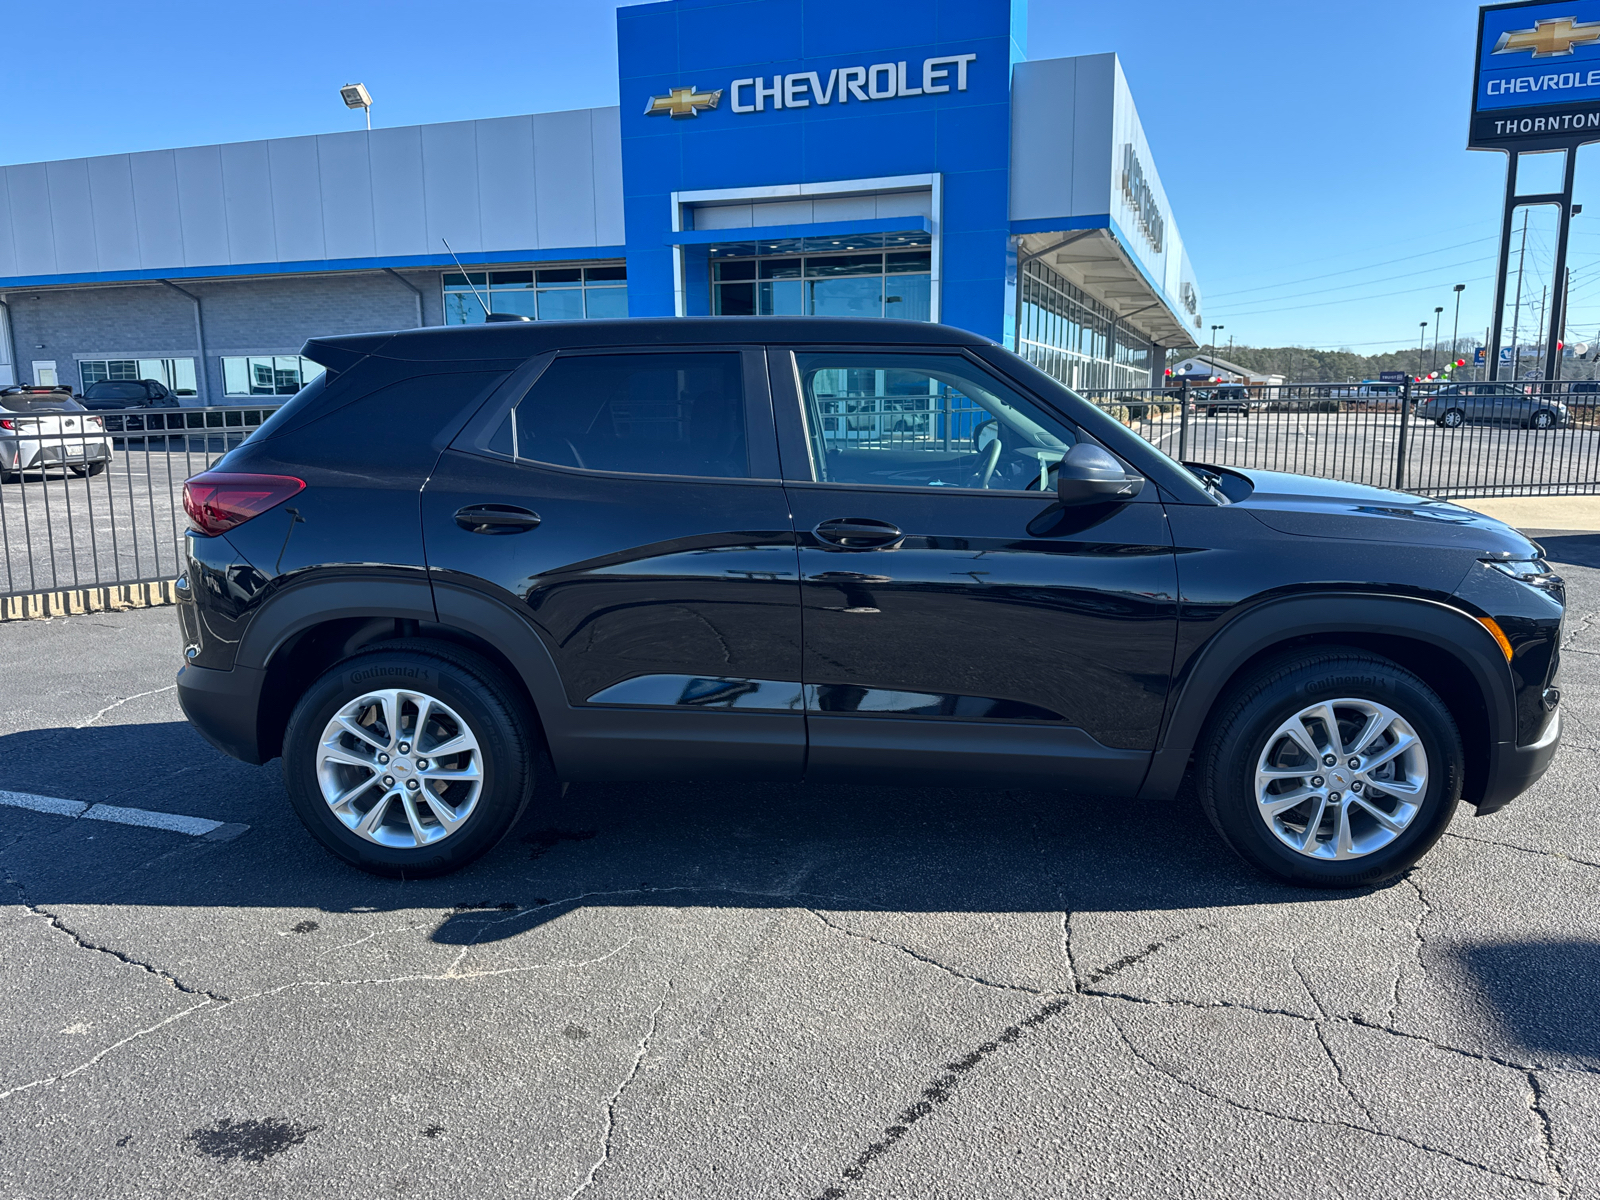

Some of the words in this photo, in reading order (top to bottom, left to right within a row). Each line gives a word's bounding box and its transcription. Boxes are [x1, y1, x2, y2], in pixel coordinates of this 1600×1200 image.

[730, 53, 976, 114] CHEVROLET
[1495, 112, 1600, 135] THORNTON
[350, 665, 420, 684] Continental
[1304, 674, 1377, 694] Continental
